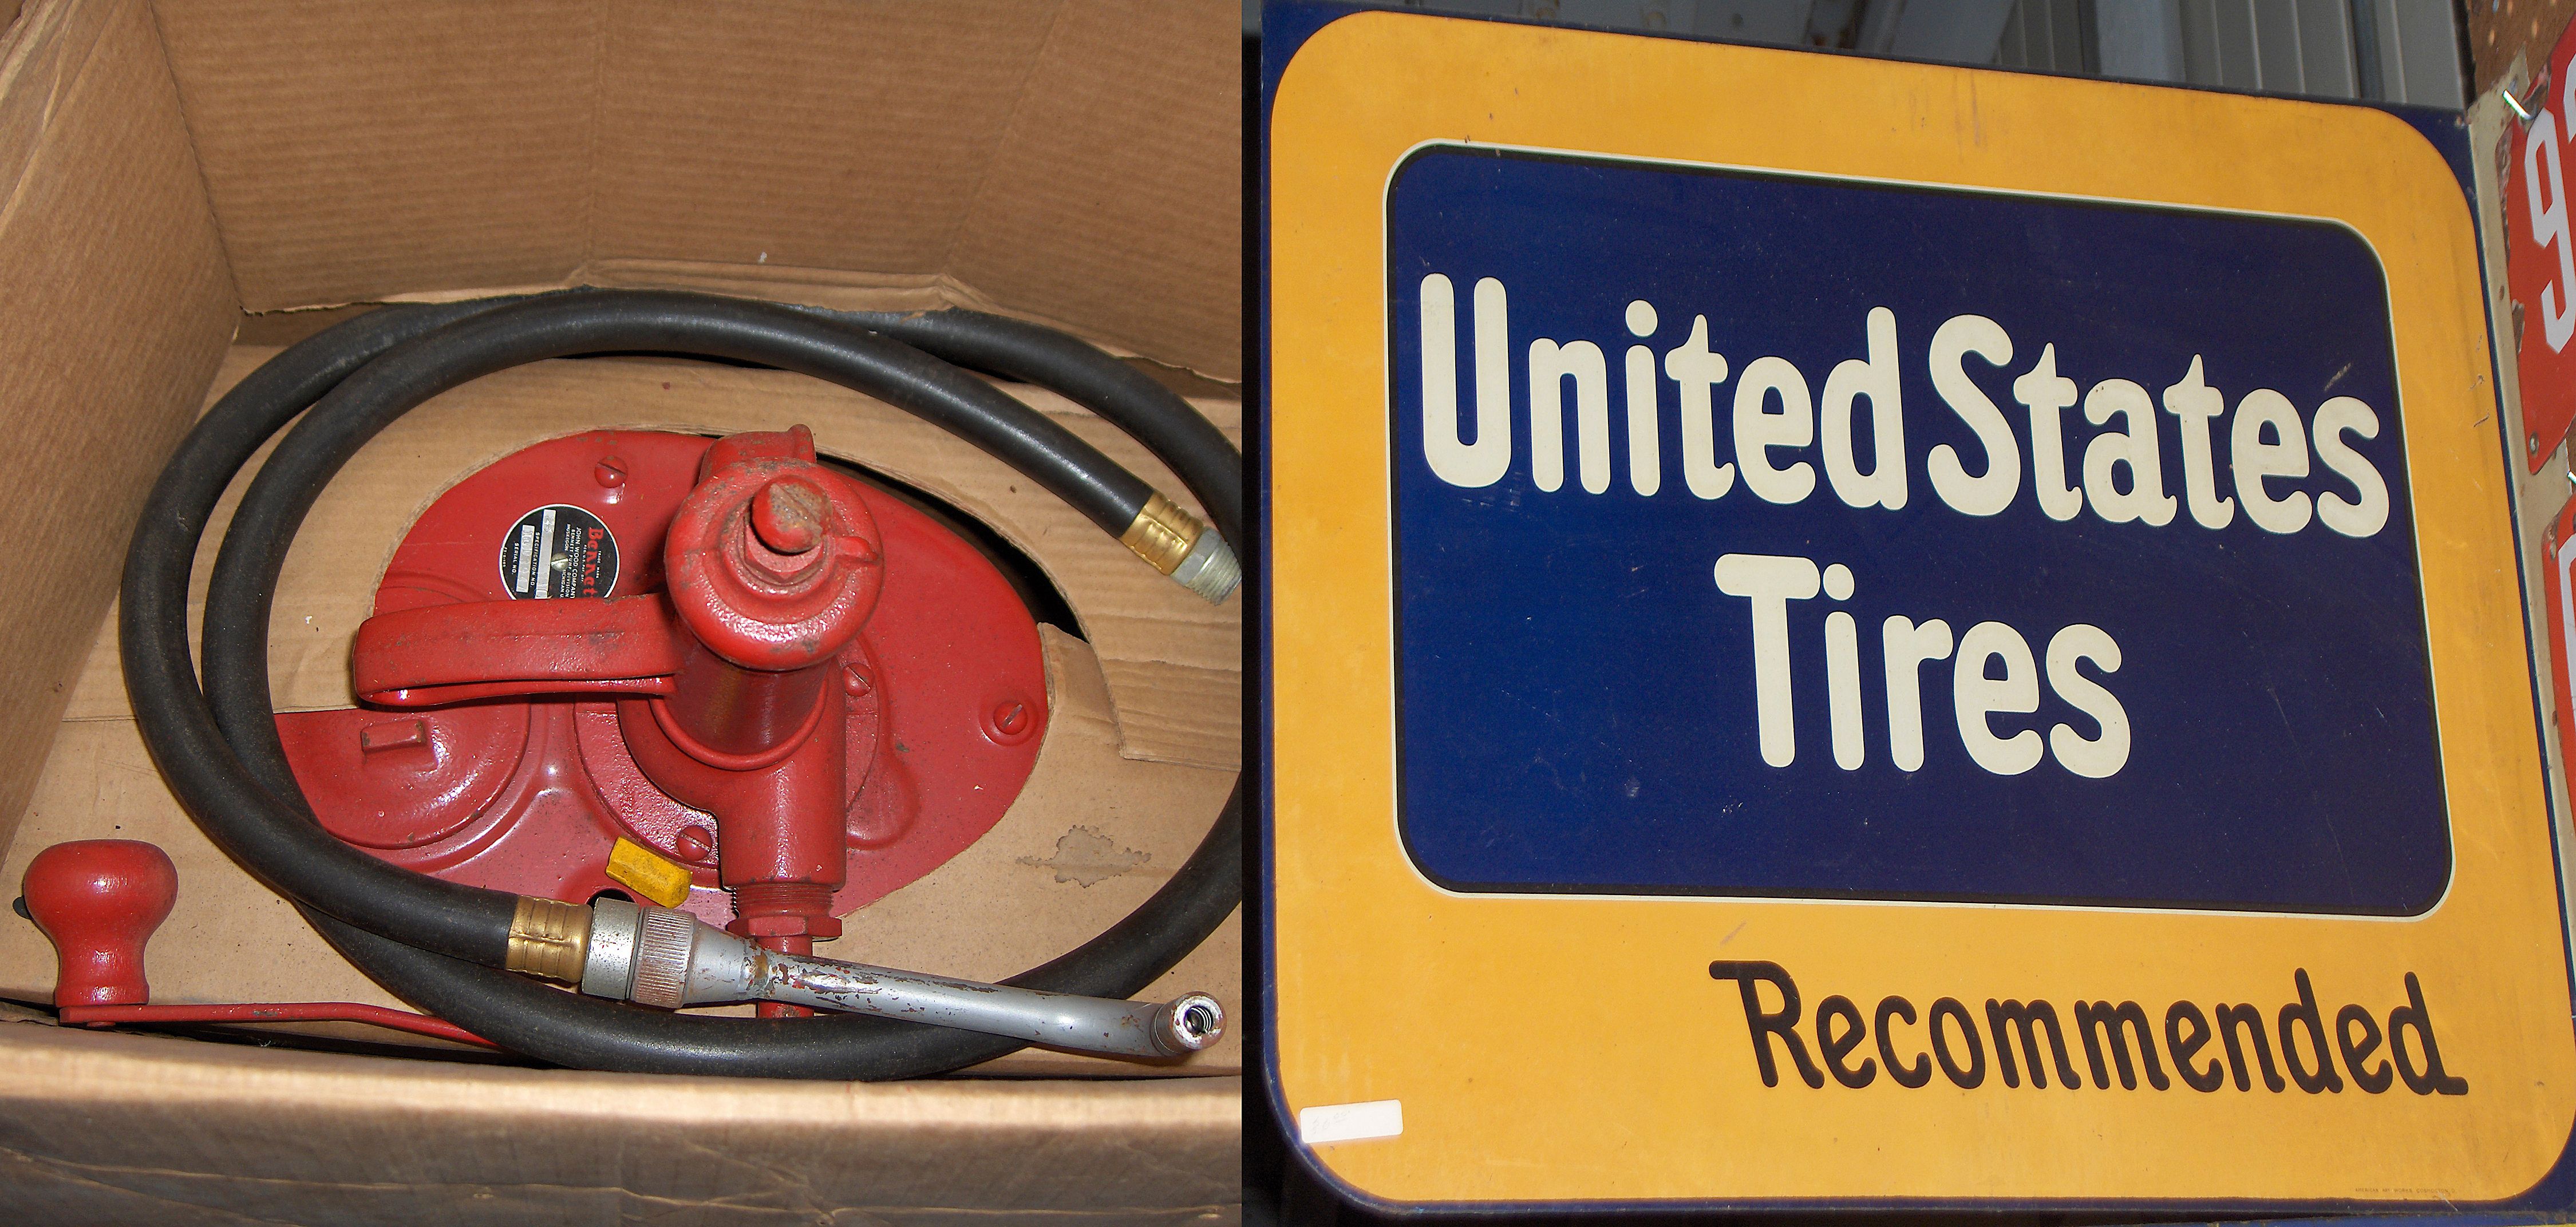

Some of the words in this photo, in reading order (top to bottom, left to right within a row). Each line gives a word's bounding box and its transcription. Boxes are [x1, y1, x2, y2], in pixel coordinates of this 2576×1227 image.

[1420, 272, 1908, 510] United
[1927, 314, 2391, 537] States
[532, 532, 540, 576] SPECIFICATION
[583, 527, 604, 599] Bennet
[1714, 553, 2131, 778] Tires
[1709, 960, 2468, 1095] Recommended
